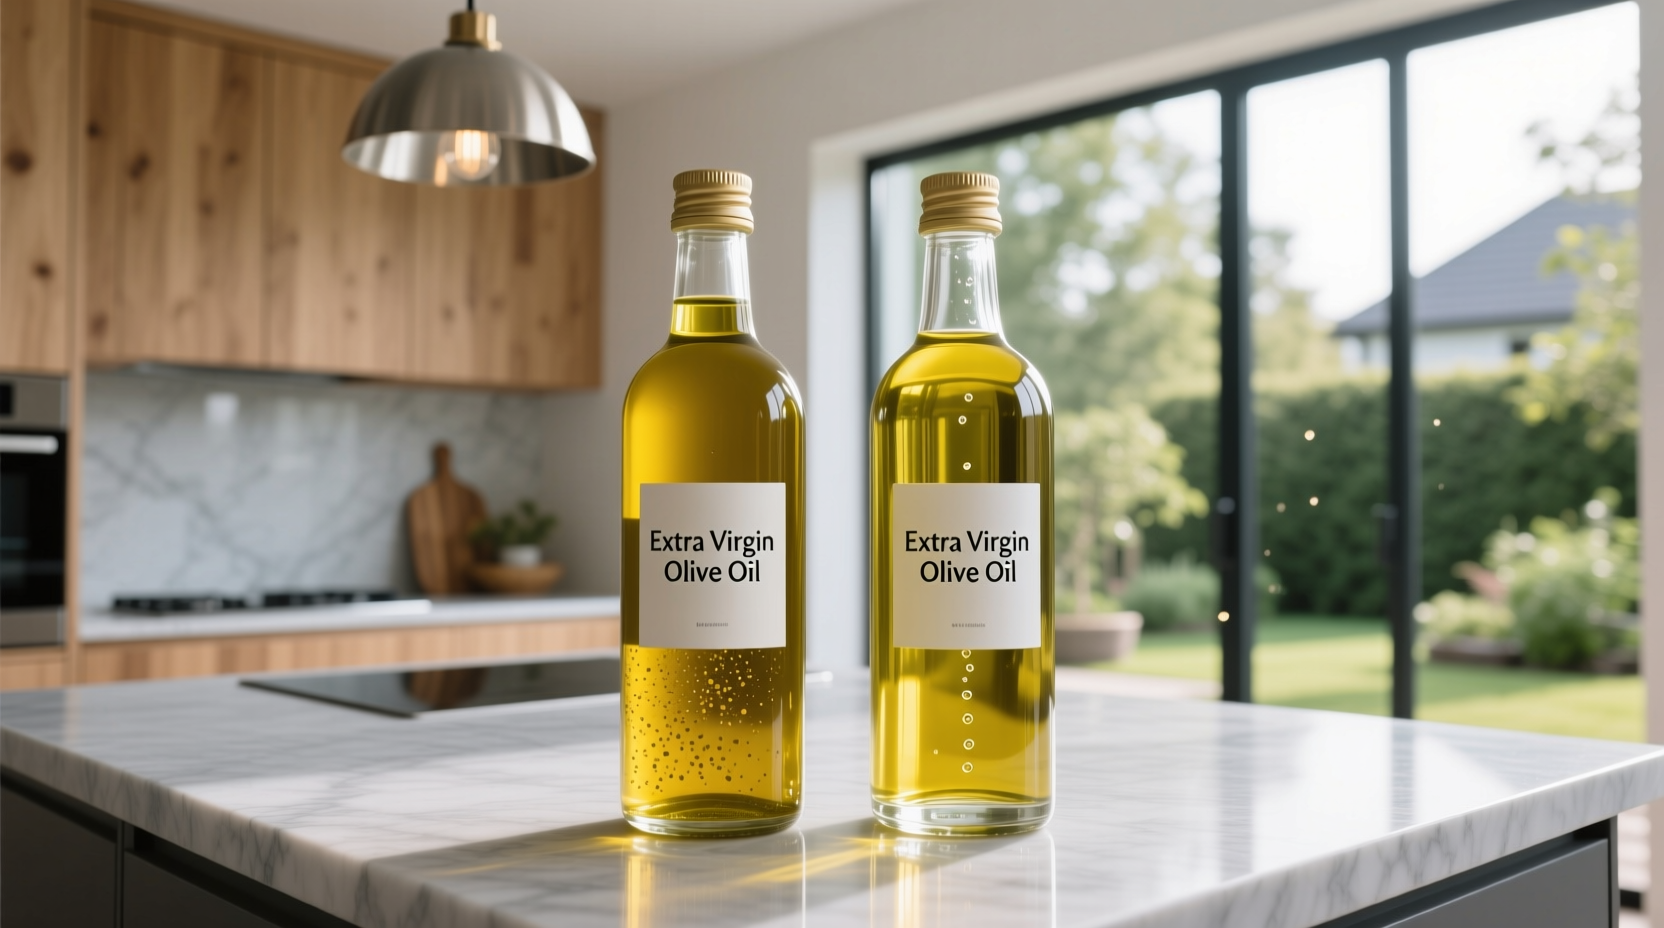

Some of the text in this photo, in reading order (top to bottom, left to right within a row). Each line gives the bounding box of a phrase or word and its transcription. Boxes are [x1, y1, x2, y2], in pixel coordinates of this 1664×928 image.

[650, 529, 774, 558] Extra Virgin
[905, 530, 1029, 558] Extra Virgin
[663, 559, 761, 583] Olive Oil
[919, 559, 1016, 583] Olive Oil
